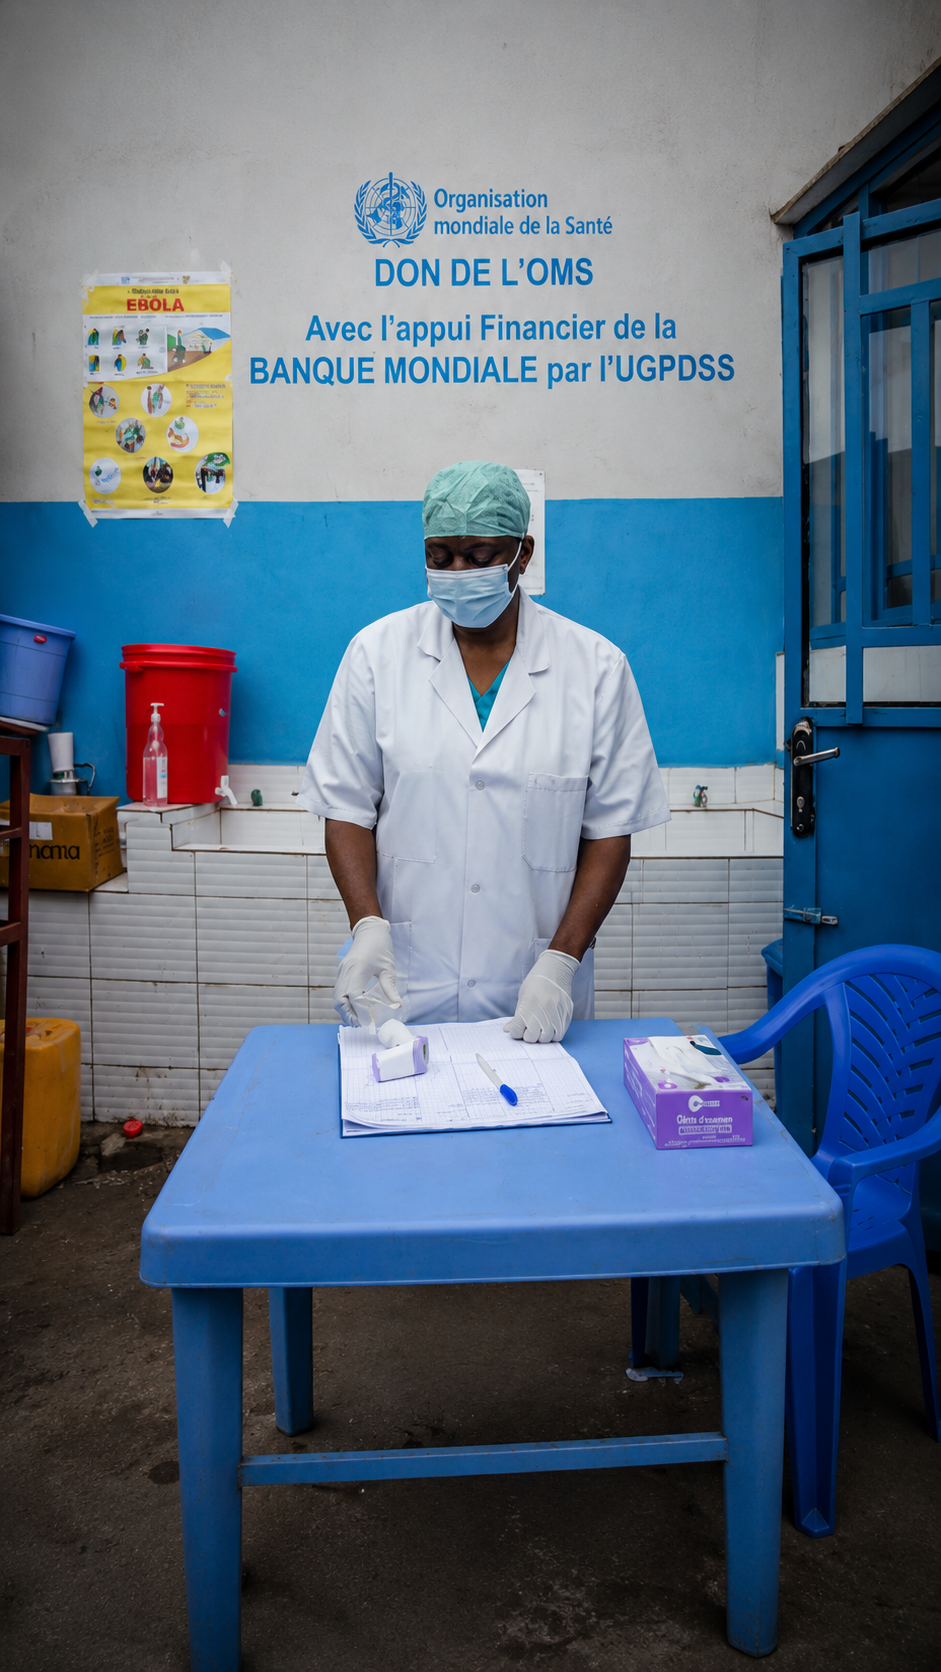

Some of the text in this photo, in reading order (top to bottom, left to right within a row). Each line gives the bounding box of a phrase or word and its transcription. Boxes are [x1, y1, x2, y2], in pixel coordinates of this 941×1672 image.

[434, 188, 548, 213] Organisation
[434, 215, 613, 236] mondiale de la Santé
[374, 257, 594, 287] DON DE L’OMS
[305, 313, 677, 347] Avec l’appui Financier de la
[249, 354, 735, 390] BANQUE MONDIALE par l’UGPDSS
